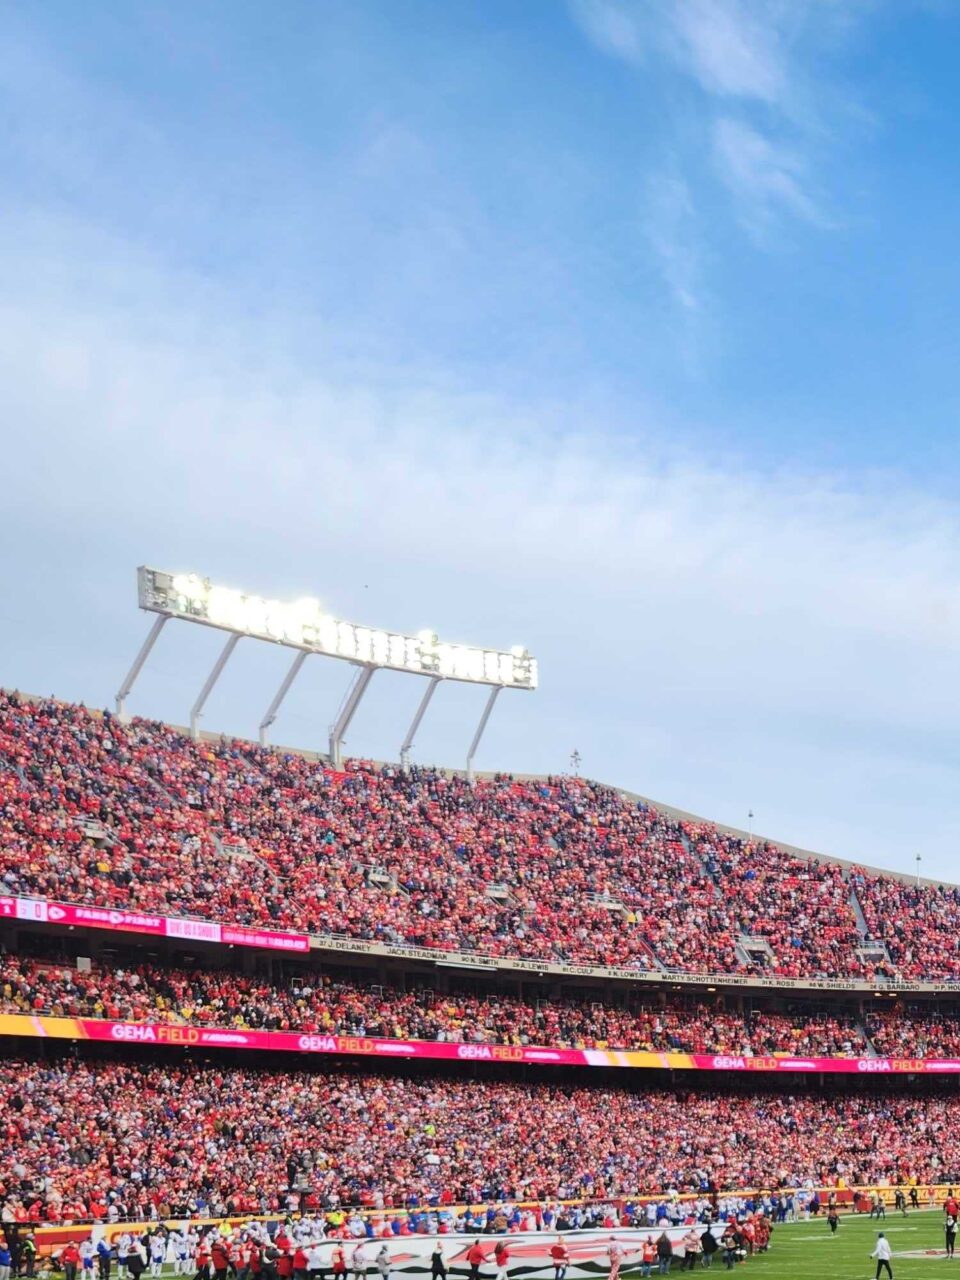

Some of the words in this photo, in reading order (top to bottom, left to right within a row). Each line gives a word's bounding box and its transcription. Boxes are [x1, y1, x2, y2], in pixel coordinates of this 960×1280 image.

[336, 942, 371, 952] DELANEY
[387, 948, 406, 956] JACK
[408, 950, 448, 960] STEADMAN
[478, 957, 499, 966] SMITH
[686, 976, 748, 984] SCHOTTENHEIMER
[112, 1024, 156, 1040] GEHA
[158, 1028, 198, 1043] FIELD
[298, 1036, 336, 1050] GEHA
[338, 1038, 373, 1052] FIELD
[458, 1045, 490, 1058] GEHA
[492, 1047, 523, 1060] FIELD
[714, 1057, 745, 1068] GEHA
[746, 1058, 777, 1069] FIELD
[858, 1060, 890, 1070] GEHA
[892, 1060, 923, 1070] FIELD
